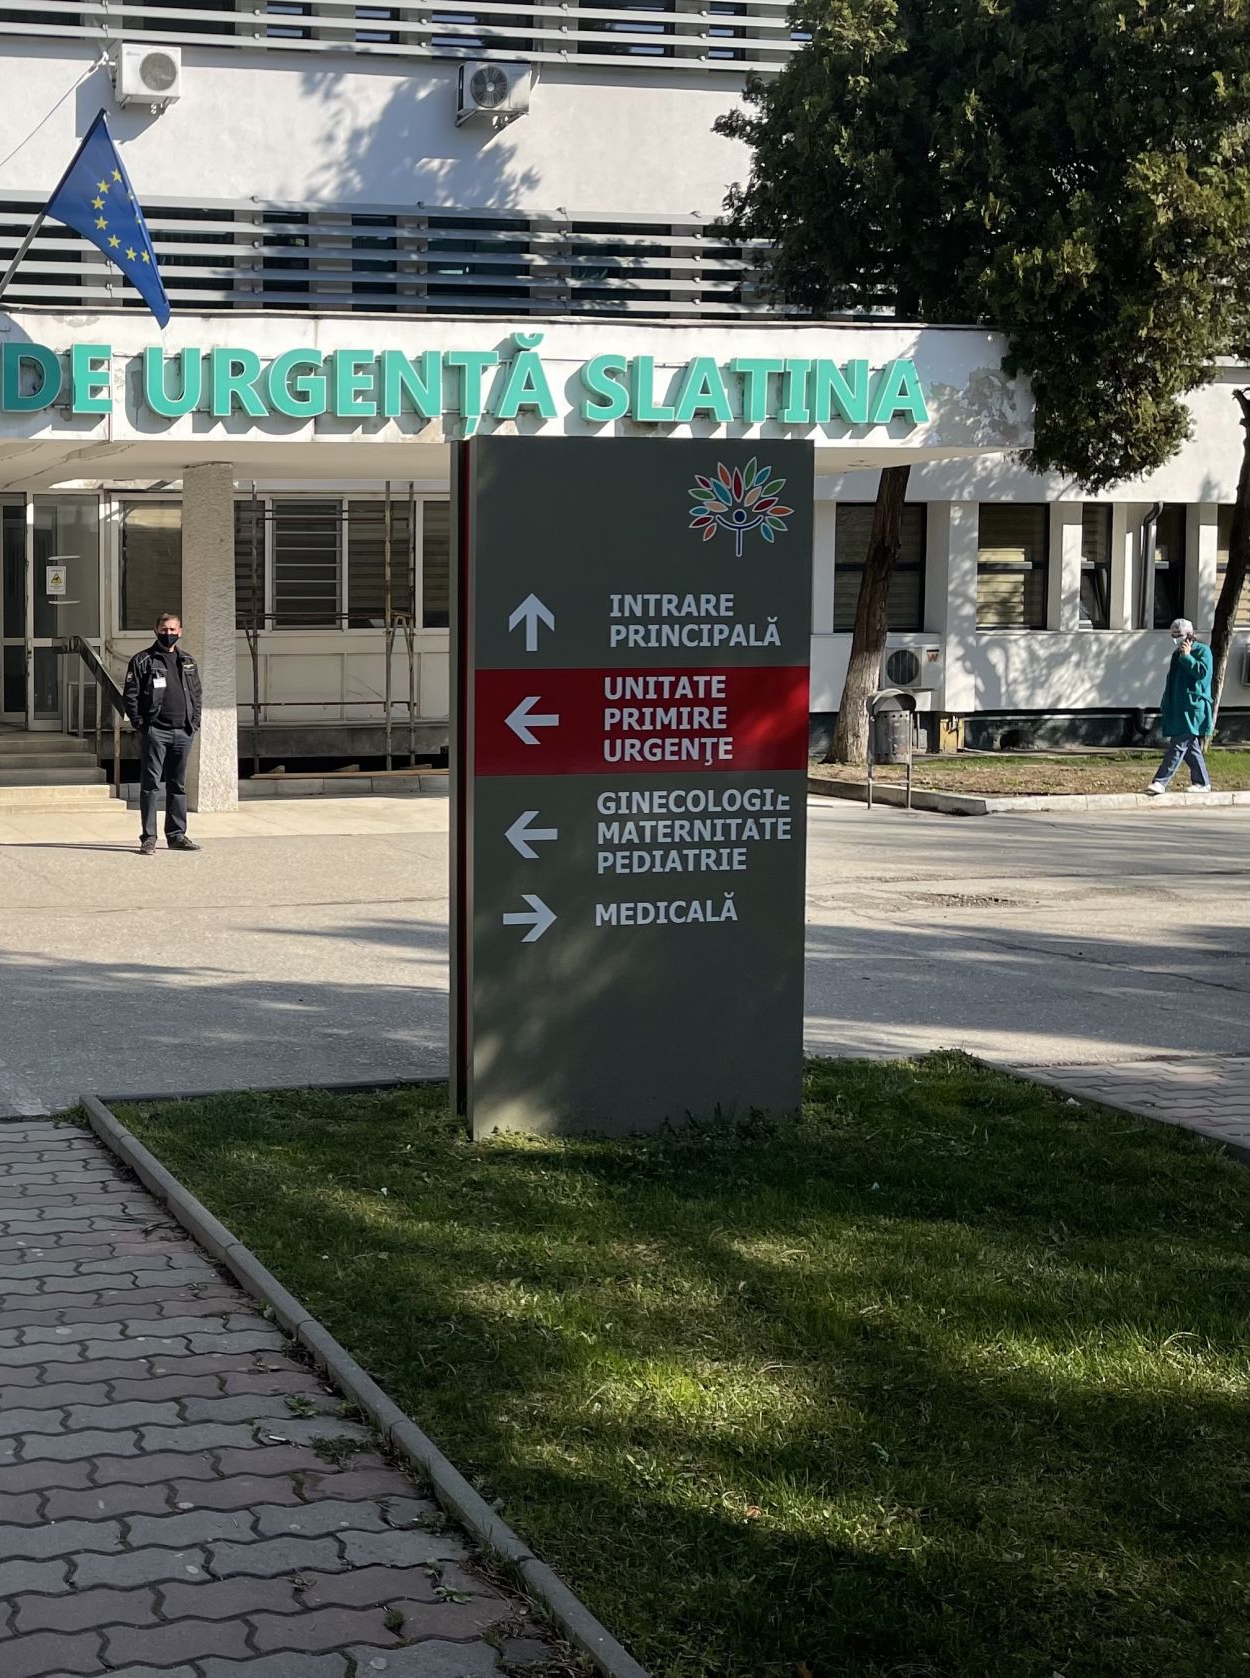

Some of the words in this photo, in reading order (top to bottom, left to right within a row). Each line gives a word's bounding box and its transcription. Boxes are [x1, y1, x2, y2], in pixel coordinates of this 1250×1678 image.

[1, 342, 113, 416] DE
[580, 353, 930, 425] SLATINA
[609, 593, 735, 618] INTRARE
[610, 616, 782, 648] PRINCIPALĂ
[604, 675, 727, 700] UNITATE
[604, 706, 728, 731] PRIMIRE
[597, 817, 792, 845] MATERNITATE
[597, 847, 748, 875] PEDIATRIE
[595, 891, 739, 927] MEDICALĂ
